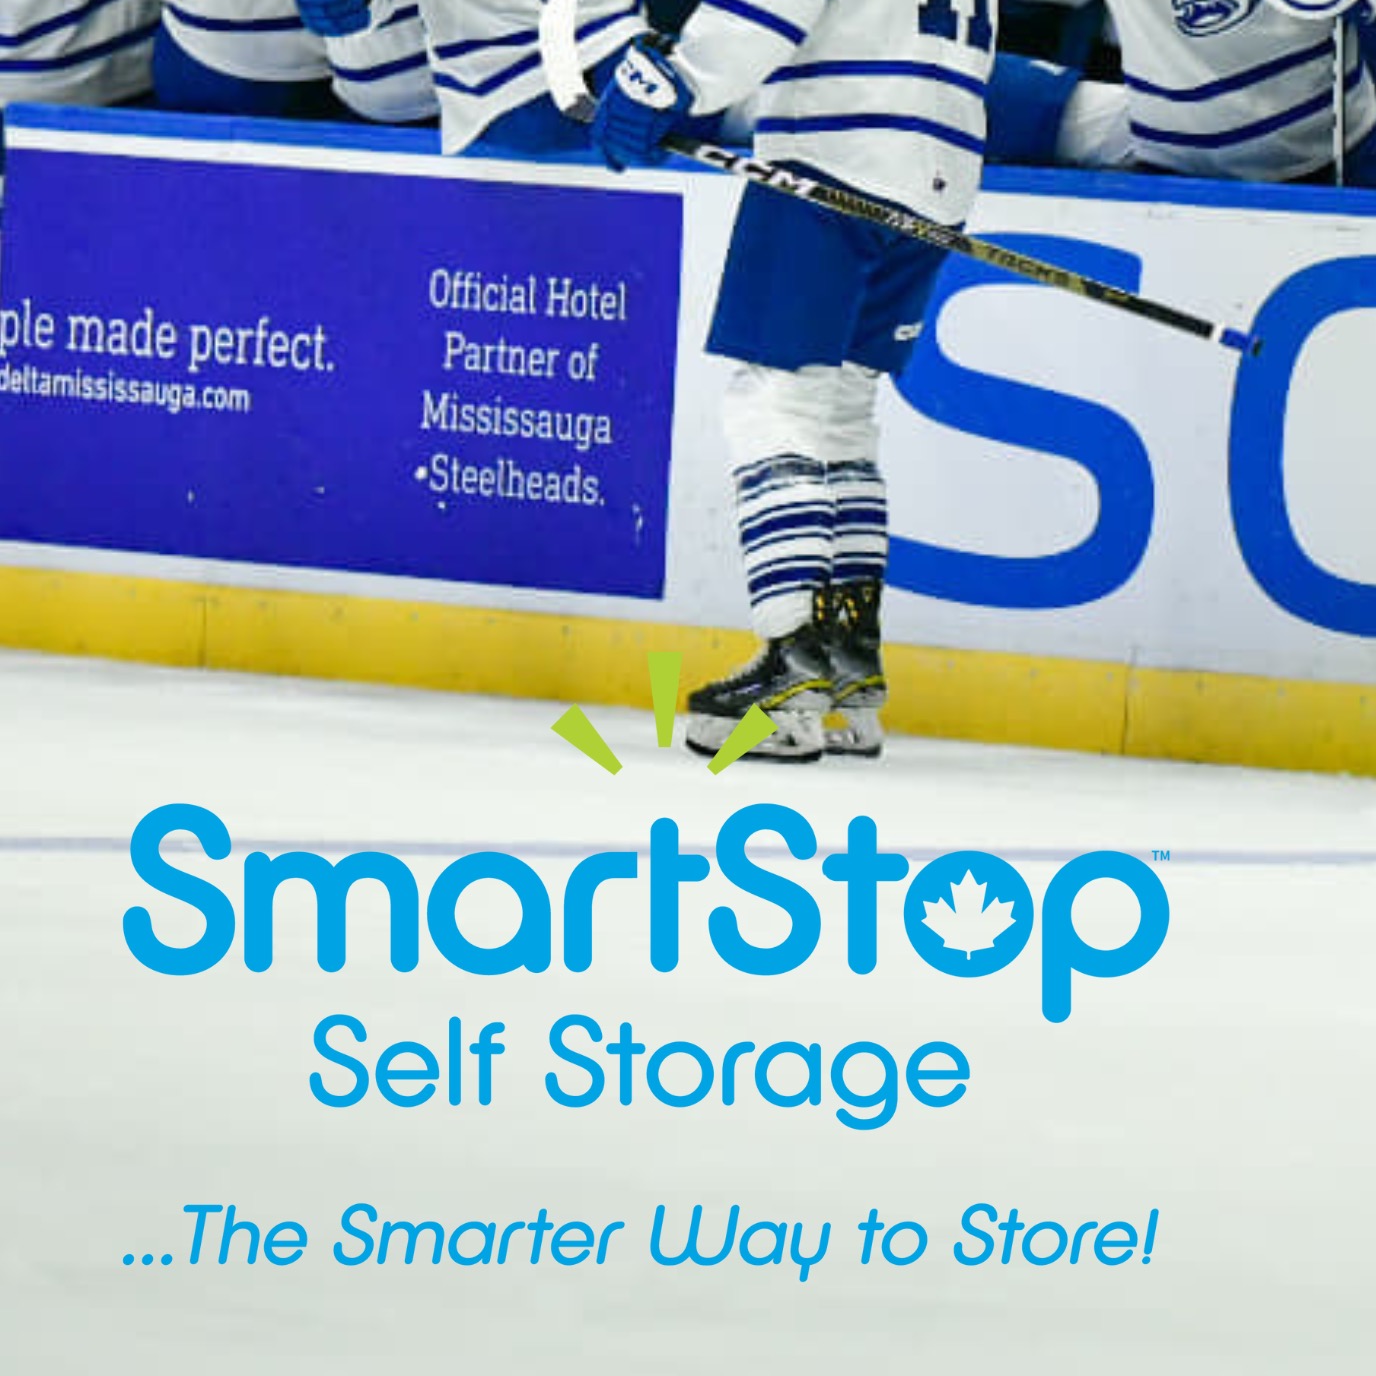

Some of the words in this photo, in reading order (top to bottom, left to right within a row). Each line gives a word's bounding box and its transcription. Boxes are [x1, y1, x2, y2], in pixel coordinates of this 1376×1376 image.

[429, 267, 537, 316] Official
[545, 276, 628, 321] Hotel
[66, 306, 179, 360] made
[188, 315, 335, 373] perfect.
[442, 330, 561, 380] Partner
[567, 341, 601, 383] of
[0, 362, 251, 415] deltamississauga.com
[420, 388, 613, 453] Mississauga
[429, 452, 606, 507] Steelheads.
